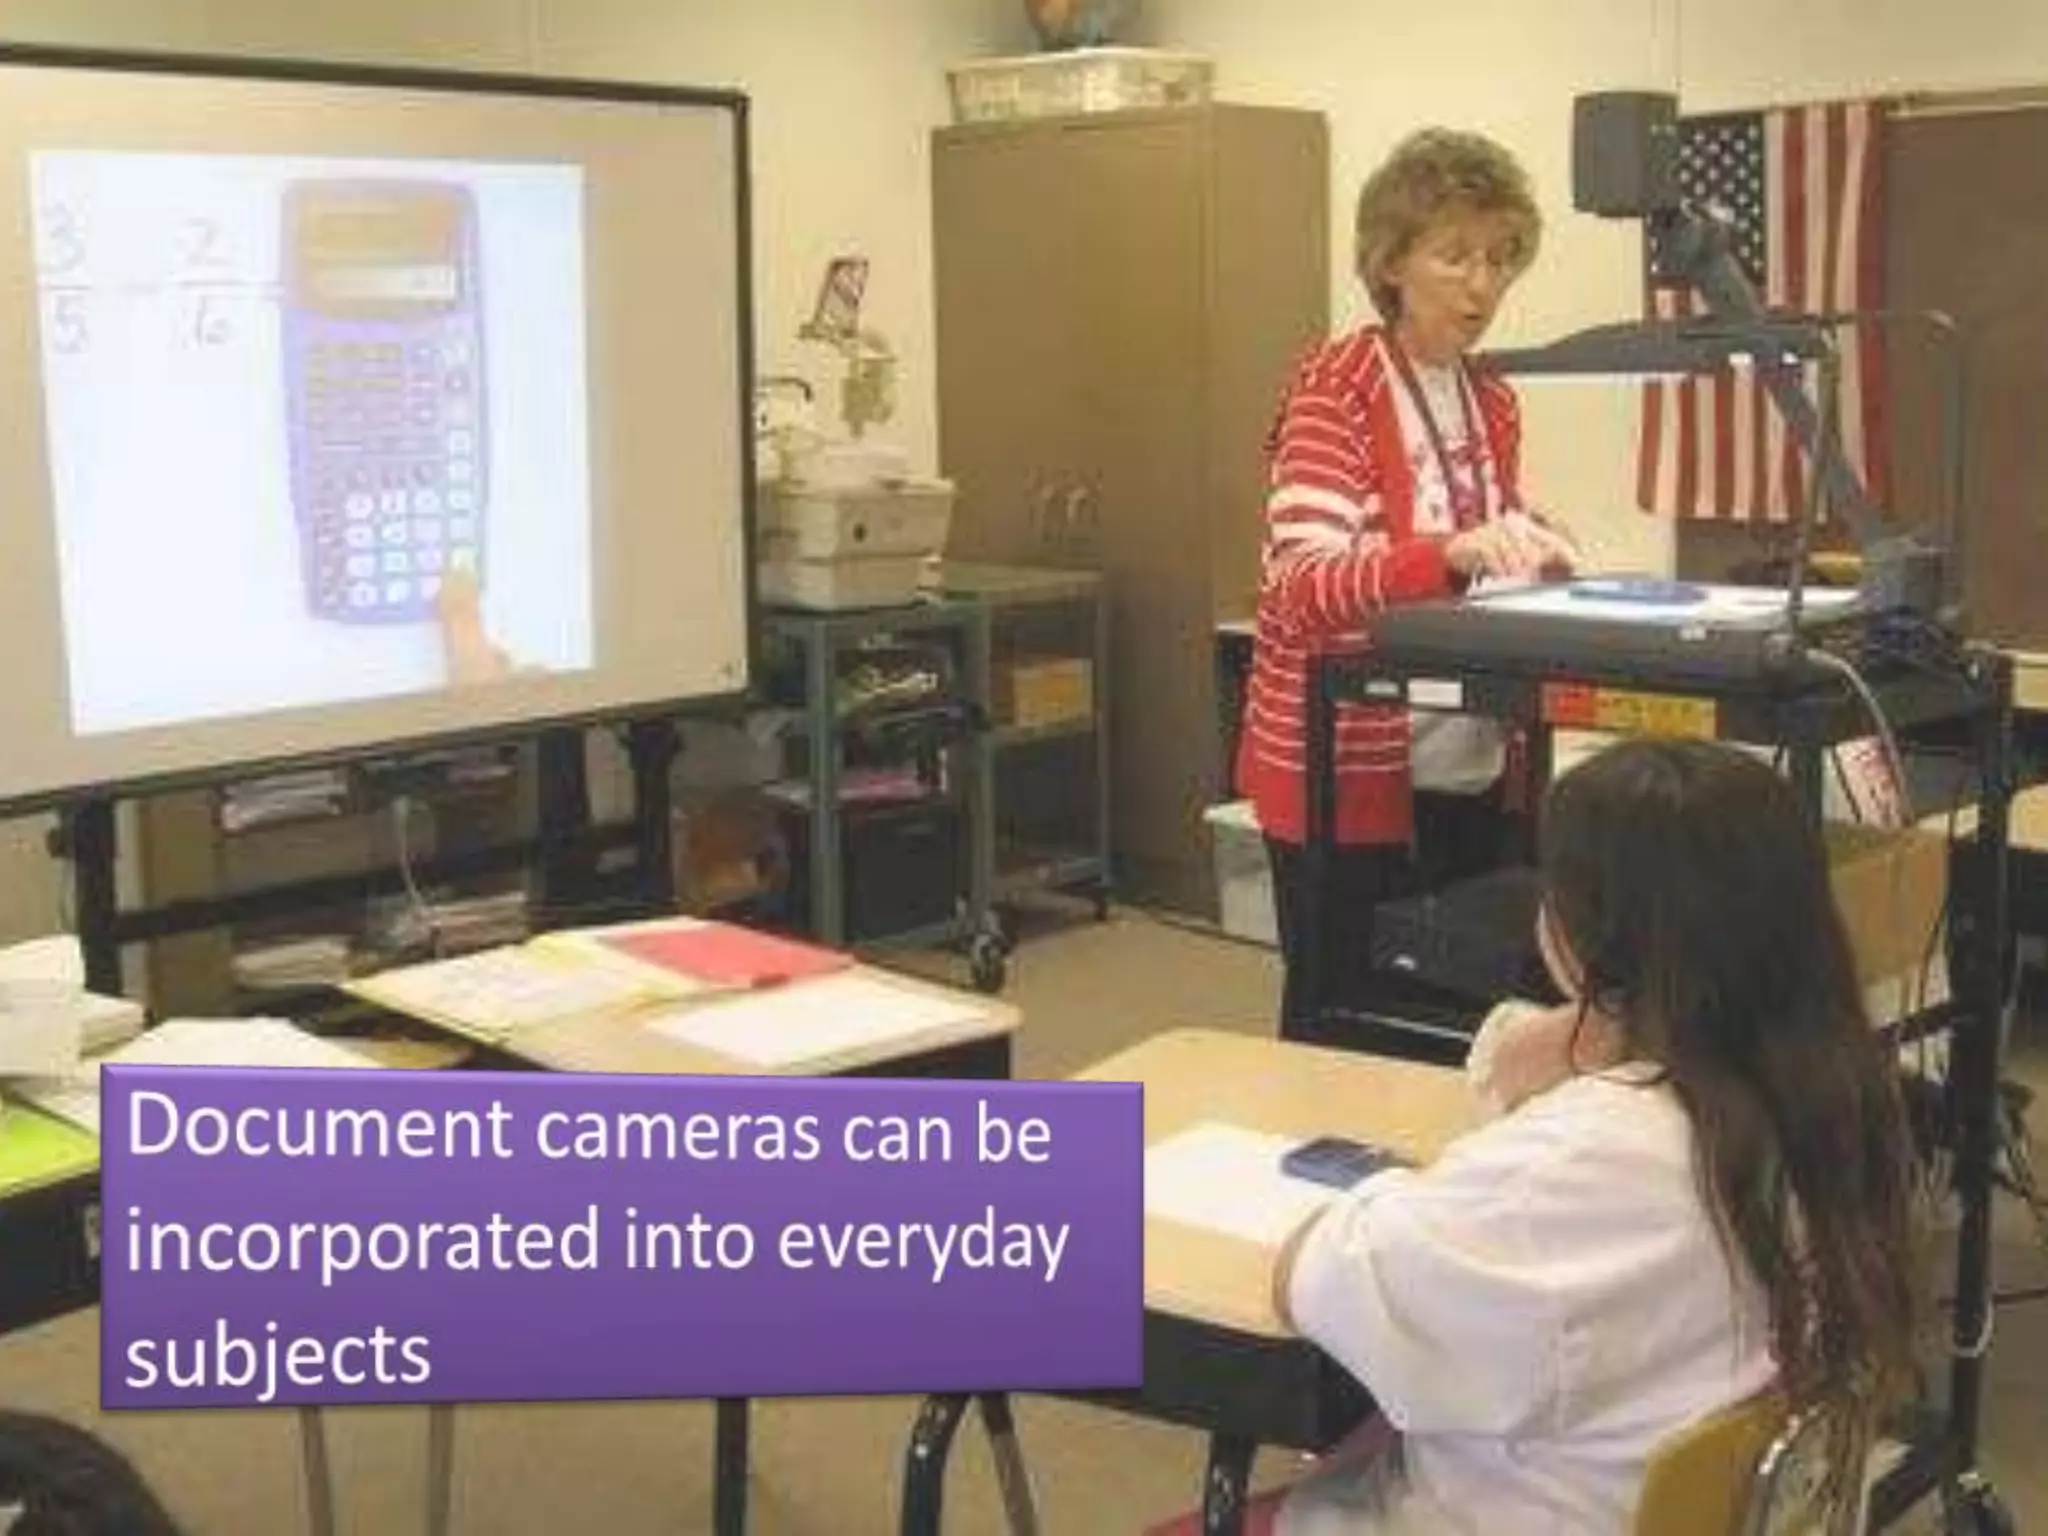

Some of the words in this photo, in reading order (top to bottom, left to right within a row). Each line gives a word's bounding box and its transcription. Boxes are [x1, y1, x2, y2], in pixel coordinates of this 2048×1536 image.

[40, 201, 87, 274] 3
[173, 215, 240, 268] 2
[53, 294, 90, 355] 5
